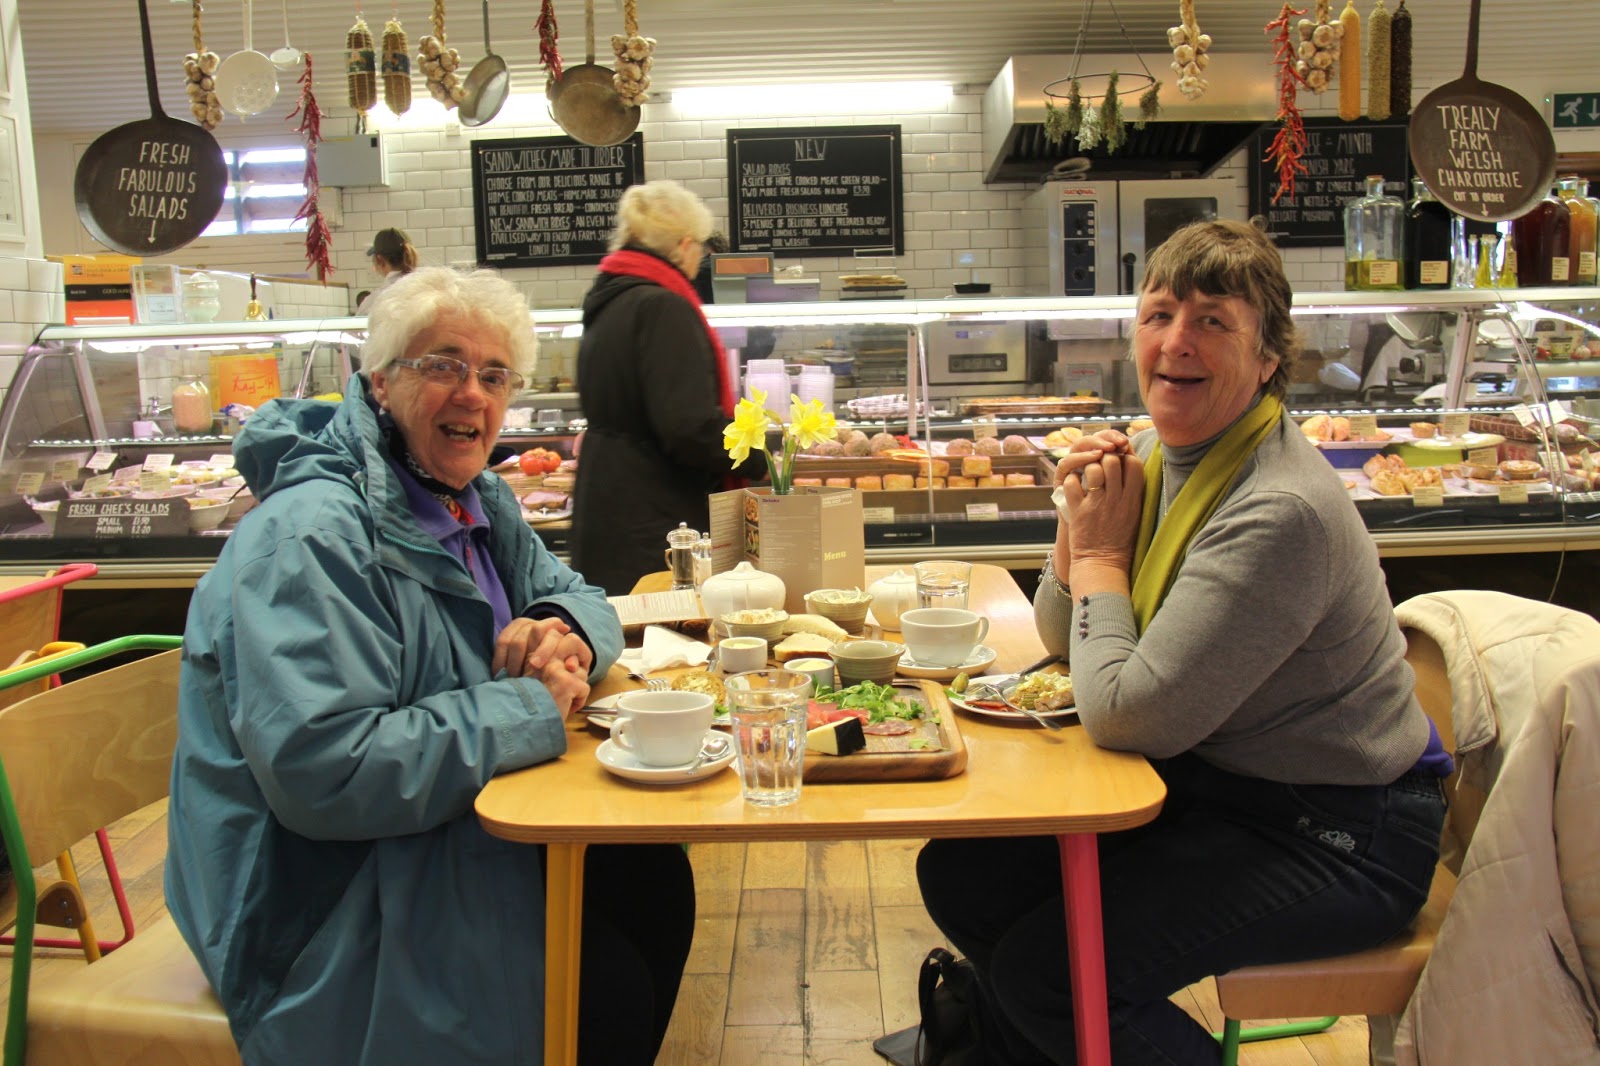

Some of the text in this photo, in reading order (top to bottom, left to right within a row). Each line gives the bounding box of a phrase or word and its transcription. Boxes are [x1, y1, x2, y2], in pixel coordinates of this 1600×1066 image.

[1437, 105, 1500, 131] TREALY
[1450, 130, 1492, 150] FARM
[140, 142, 190, 164] FRESH
[795, 139, 827, 160] NEW
[485, 147, 625, 172] SANDWICHES MADE TO ORDER
[1448, 149, 1503, 170] WELSH
[742, 164, 765, 175] SALAD
[118, 168, 196, 193] FABULOUS
[487, 173, 623, 190] CHOOSE FROM OUR DELICIOUS RANGE OF
[742, 178, 748, 186] A
[1438, 169, 1522, 188] CHARCUTERIE
[488, 192, 509, 203] HOME
[742, 188, 757, 197] TWO
[1453, 192, 1504, 203] CUT TO ORDER
[129, 194, 188, 220] SALADS
[489, 206, 496, 216] IN
[531, 204, 551, 214] FRESH
[743, 204, 782, 216] DELIVERED
[819, 203, 848, 215] LUNCHES
[490, 219, 513, 231] NEW
[575, 216, 585, 227] AN
[587, 216, 605, 227] EVEN
[544, 232, 550, 241] TO
[579, 231, 596, 240] FARM
[529, 245, 548, 256] LUNCH
[69, 504, 96, 515] FRESH
[134, 504, 170, 514] SALADS
[97, 517, 120, 525] SMALL
[824, 551, 847, 561] Menu
